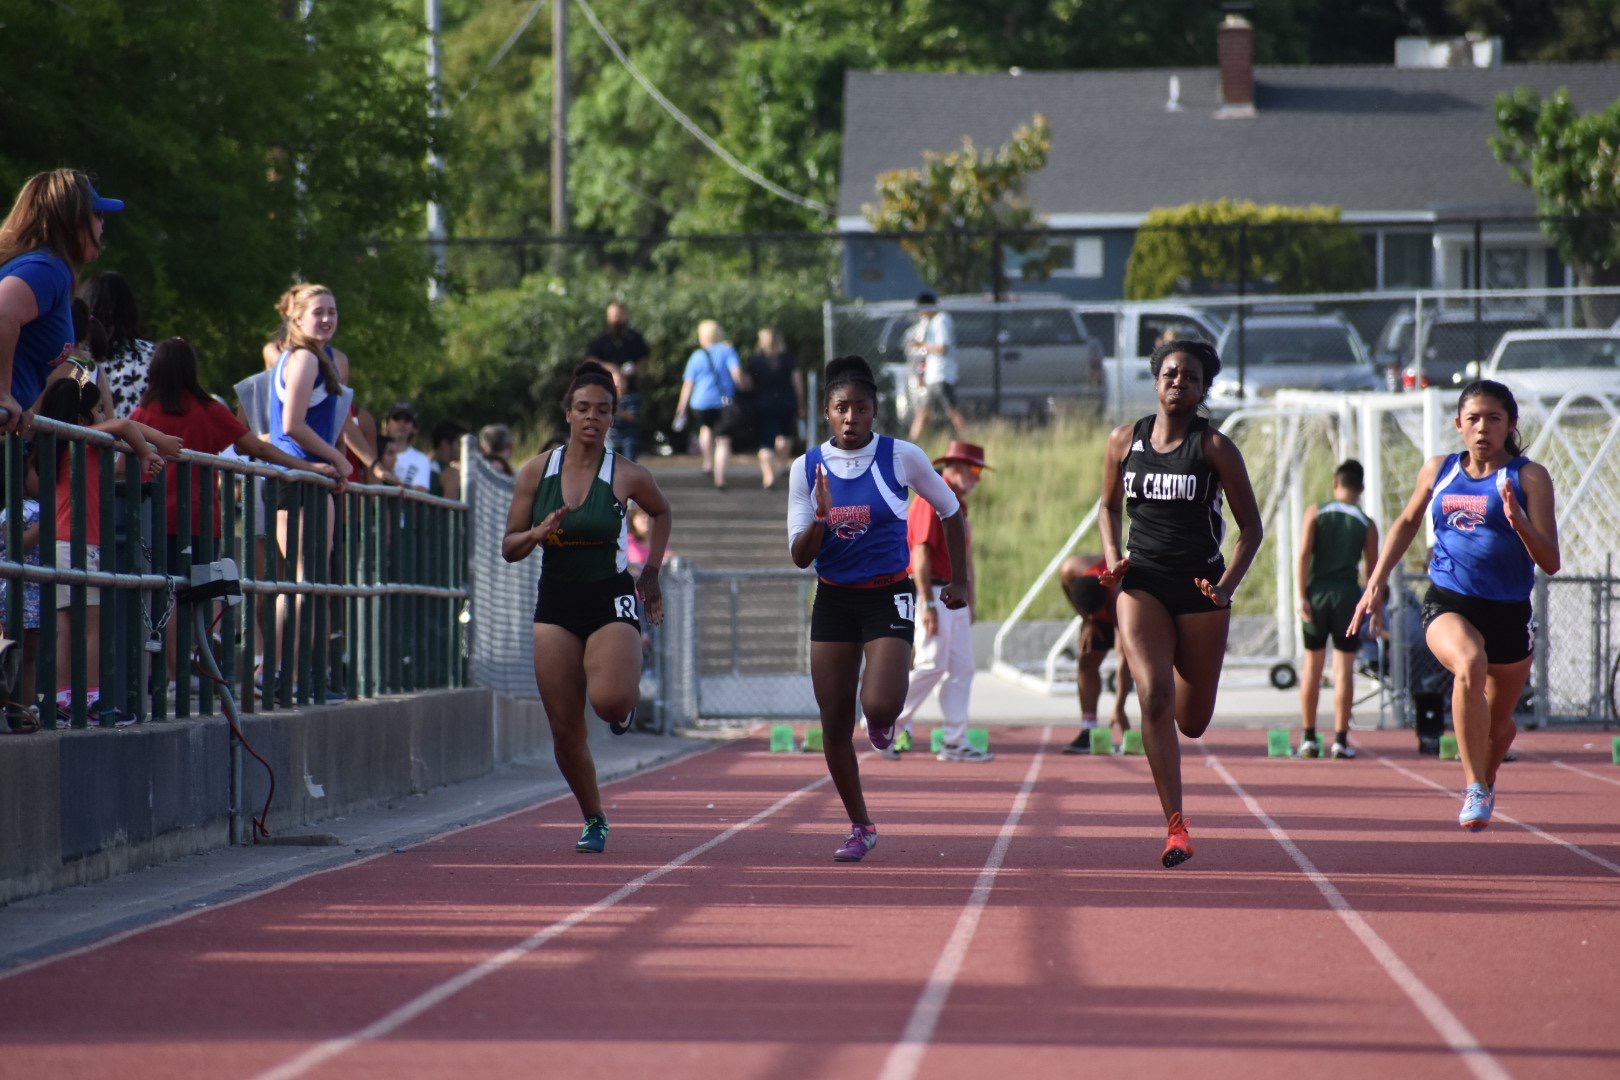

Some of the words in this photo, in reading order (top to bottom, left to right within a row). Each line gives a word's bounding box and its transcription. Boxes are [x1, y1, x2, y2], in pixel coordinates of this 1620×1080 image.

[1123, 471, 1138, 498] EL
[1143, 473, 1197, 501] CAMINO
[831, 504, 870, 514] HRISTIAN
[899, 595, 909, 619] 7
